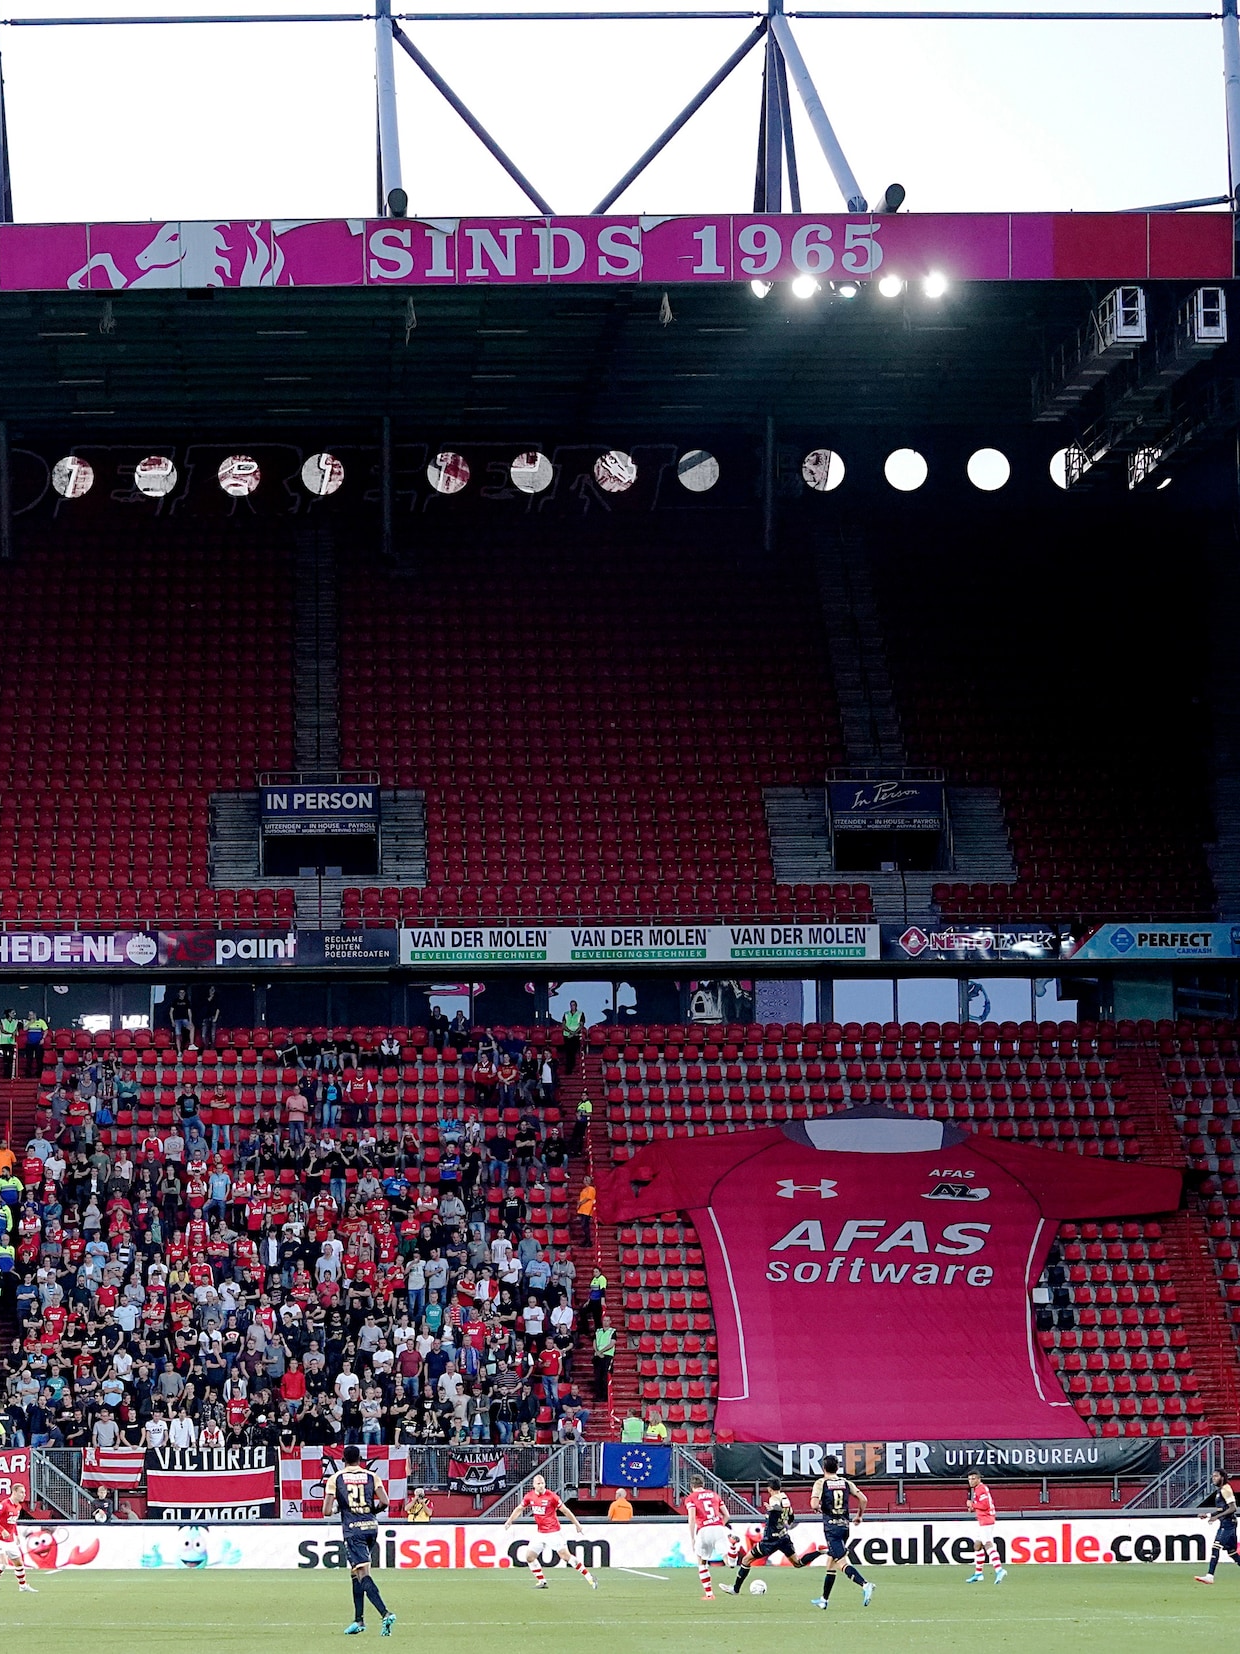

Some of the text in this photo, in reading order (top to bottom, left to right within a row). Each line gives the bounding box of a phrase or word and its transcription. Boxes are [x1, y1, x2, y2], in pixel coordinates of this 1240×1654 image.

[369, 221, 884, 281] SINDS 1965
[266, 792, 373, 810] IN PERSON
[873, 781, 920, 803] Person
[324, 935, 364, 943] RECLAME
[410, 929, 548, 948] VAN DER MOLEN
[570, 928, 707, 947] VAN DER MOLEN
[730, 927, 867, 946] VAN DER MOLEN
[1137, 932, 1213, 947] PERFECT
[216, 932, 297, 965] paint
[324, 943, 361, 951] SPUITEN
[324, 950, 390, 958] POEDERCOATEN
[413, 951, 544, 960] BEVEILIGINGSTECHNIEK
[574, 950, 703, 959] BEVEILIGINGSTECHNIEK
[734, 948, 863, 957] BEVEILIGINGSTECHNIEK
[928, 1168, 976, 1179] AFAS
[769, 1219, 992, 1256] AFAS
[765, 1256, 994, 1287] software
[155, 1446, 268, 1470] VICTORIA
[778, 1442, 1099, 1476] TREFFER UITZENDBUREAU
[346, 1483, 367, 1508] 21
[702, 1500, 715, 1520] 5
[297, 1526, 611, 1569] saisale.cm
